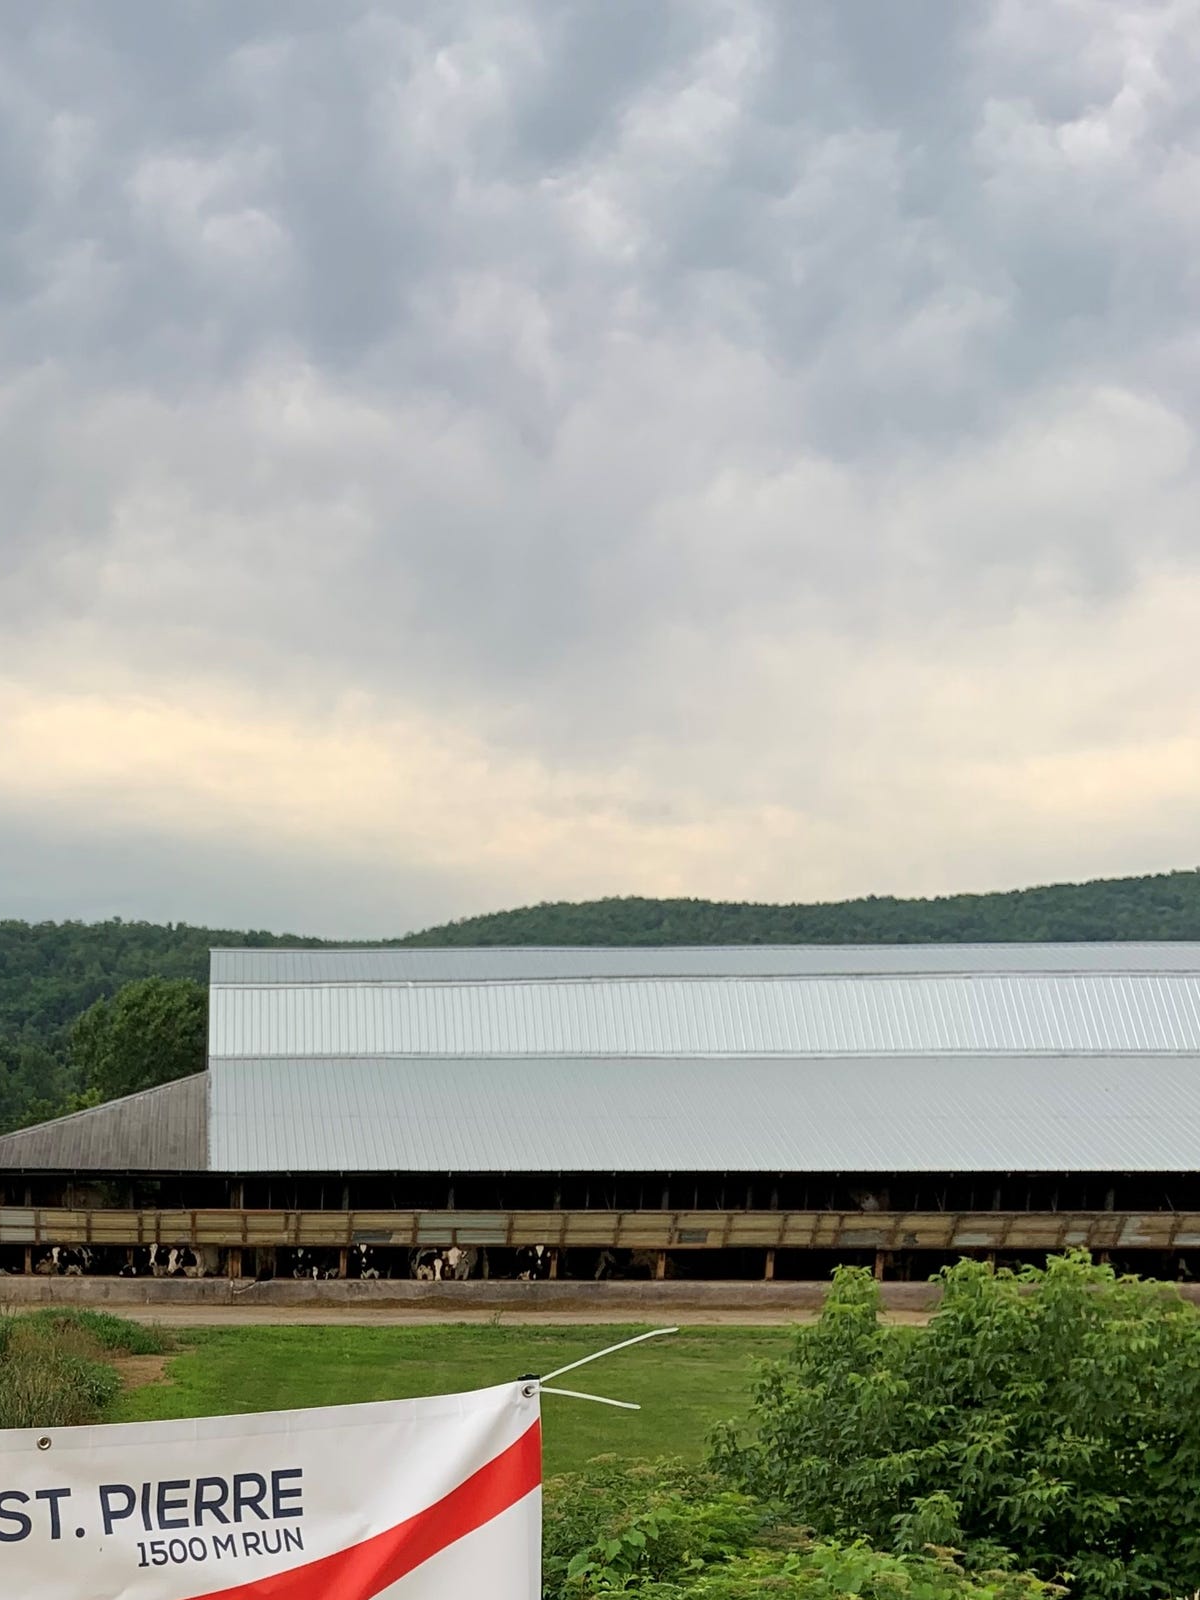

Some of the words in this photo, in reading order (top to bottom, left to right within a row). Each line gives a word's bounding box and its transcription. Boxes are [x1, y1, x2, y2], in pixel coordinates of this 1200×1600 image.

[99, 1468, 303, 1535] PIERRE
[137, 1537, 207, 1567] 1500
[212, 1534, 238, 1559] M
[242, 1527, 304, 1557] RUN
